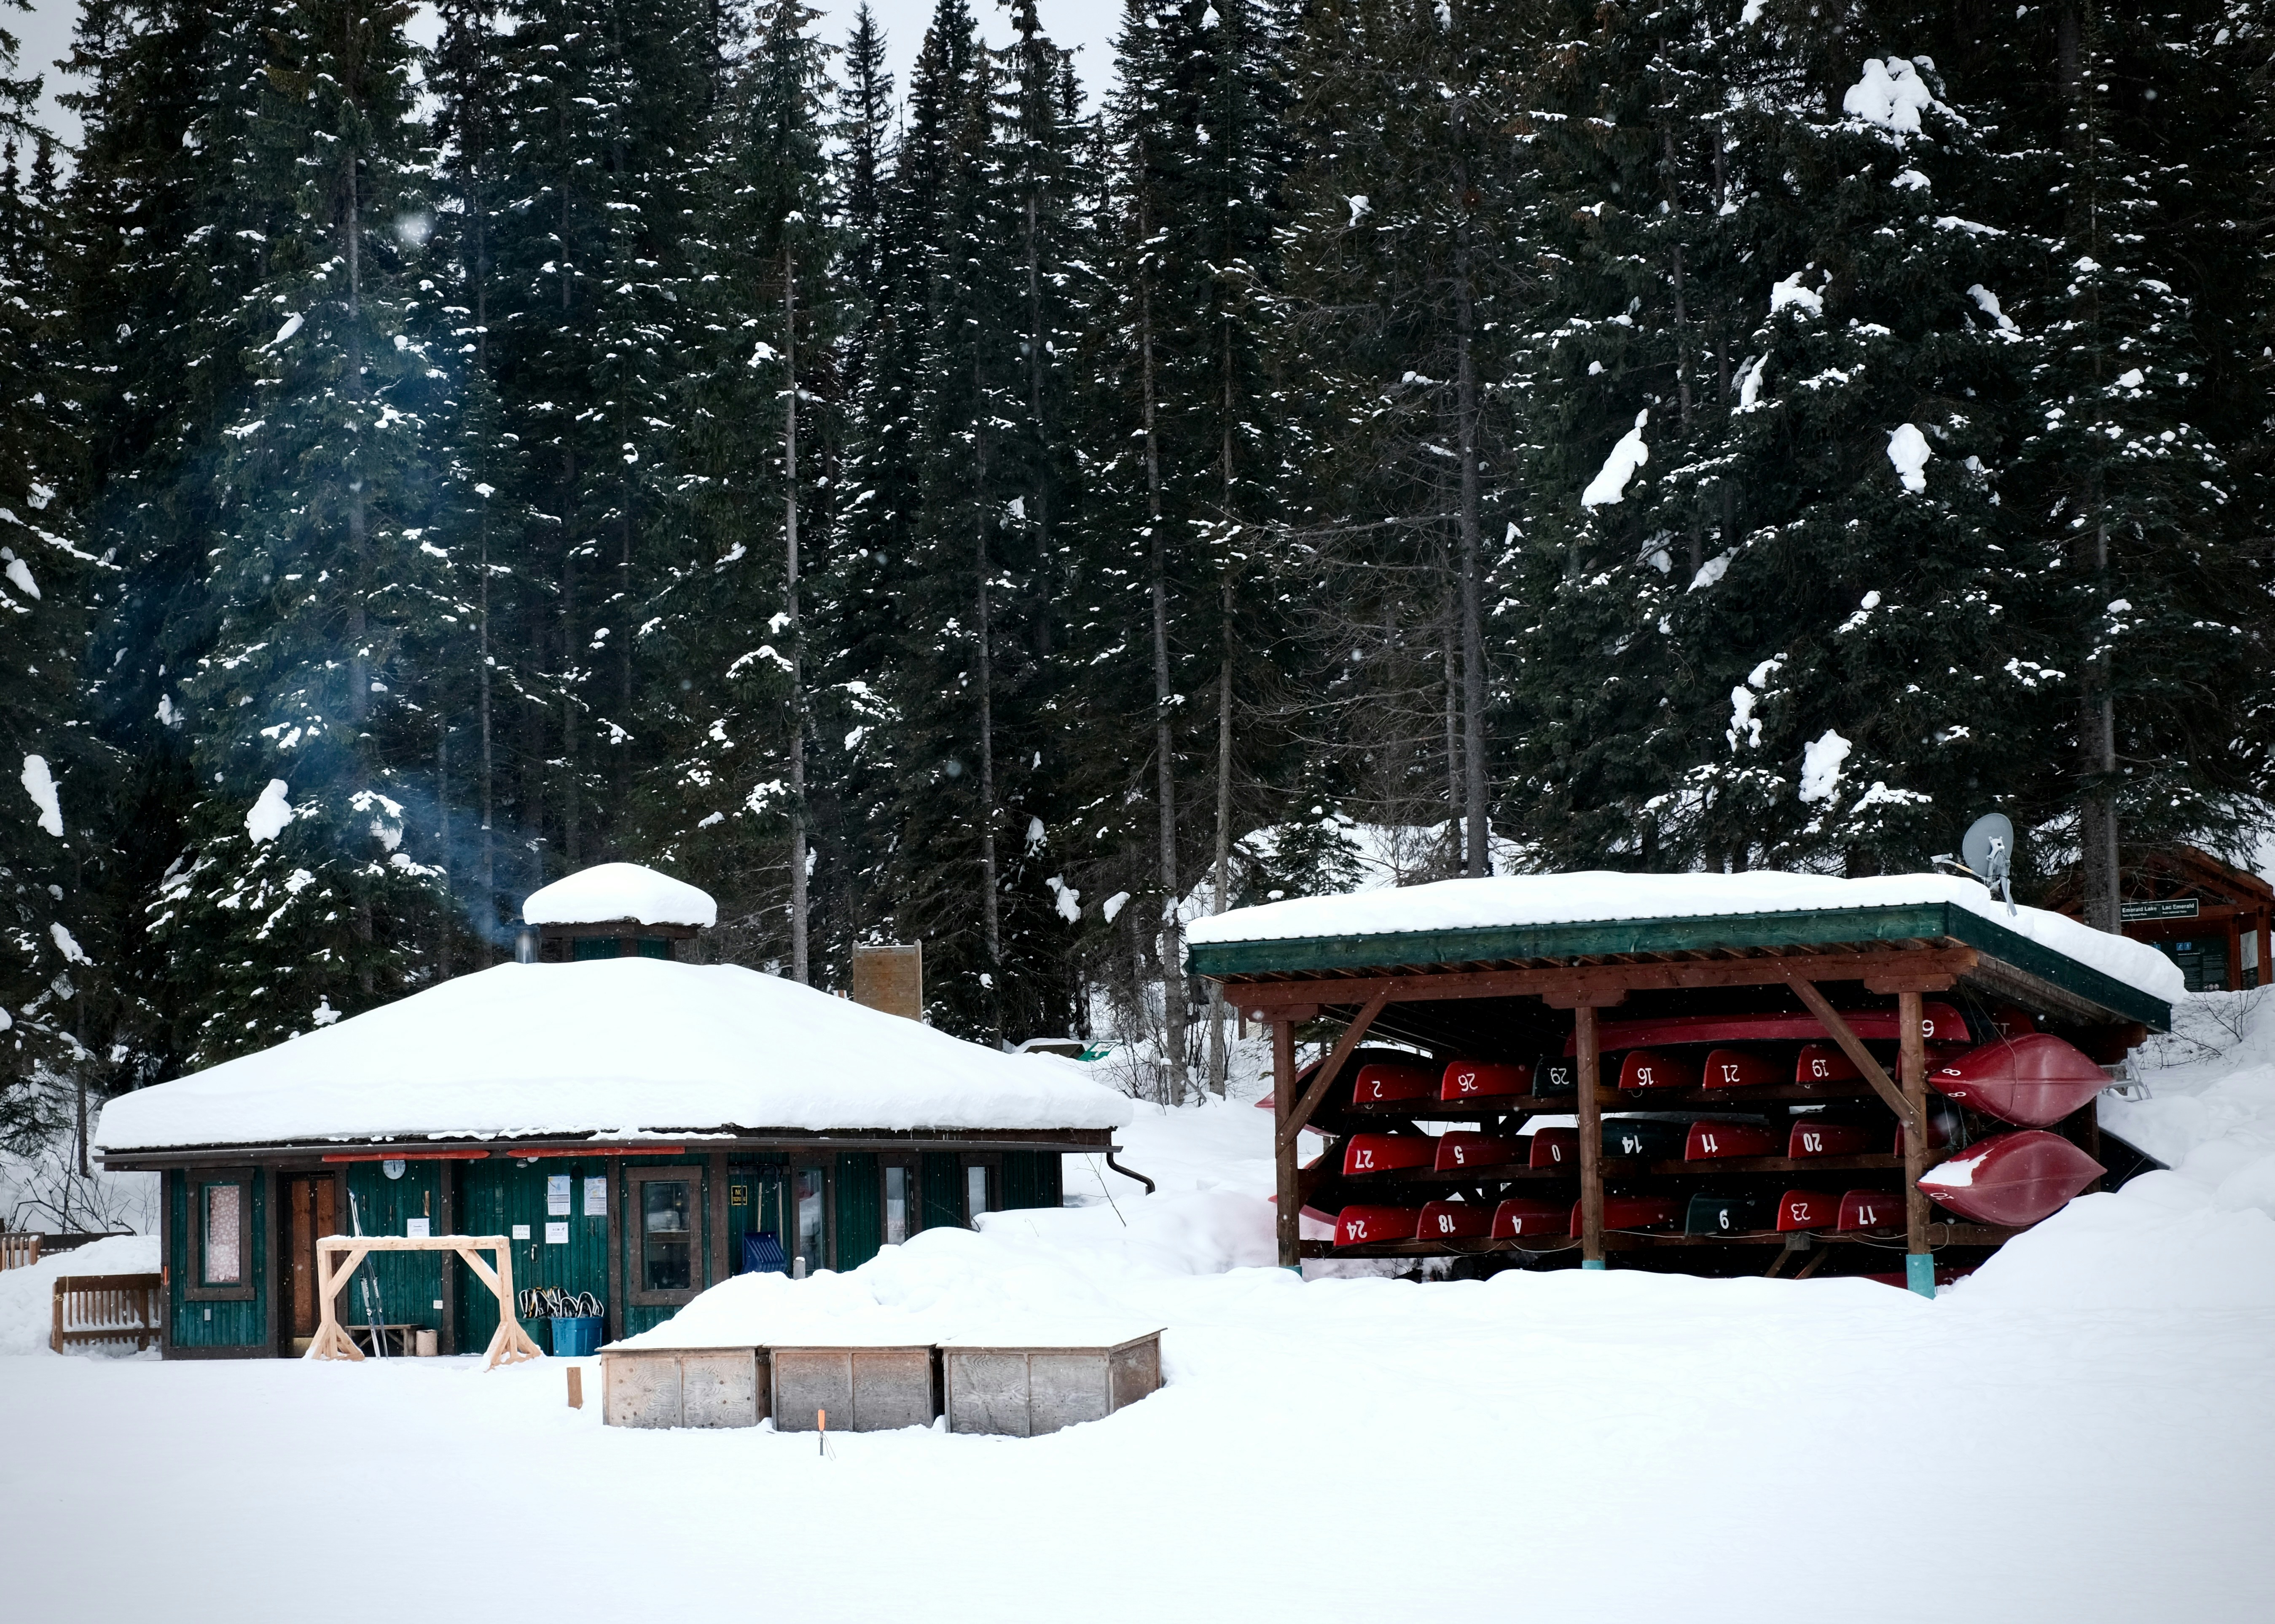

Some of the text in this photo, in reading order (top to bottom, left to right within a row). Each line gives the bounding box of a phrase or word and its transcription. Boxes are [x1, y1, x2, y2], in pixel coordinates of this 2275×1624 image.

[1550, 1068, 1569, 1084] 29
[1637, 1068, 1654, 1086] 16
[1721, 1065, 1740, 1083] 21
[1812, 1059, 1829, 1077] 19
[1372, 1081, 1383, 1098] 2
[1458, 1073, 1478, 1092] 26
[1622, 1135, 1642, 1154] 14
[1701, 1134, 1718, 1153] 11
[1803, 1133, 1822, 1152] 20
[1355, 1150, 1374, 1168] 27
[1454, 1146, 1464, 1164] 5
[1552, 1144, 1561, 1162] 0
[1791, 1203, 1810, 1221] 23
[1859, 1205, 1877, 1225] 17
[1346, 1220, 1367, 1240] 24
[1438, 1215, 1456, 1233] 18
[1512, 1216, 1522, 1234] 4
